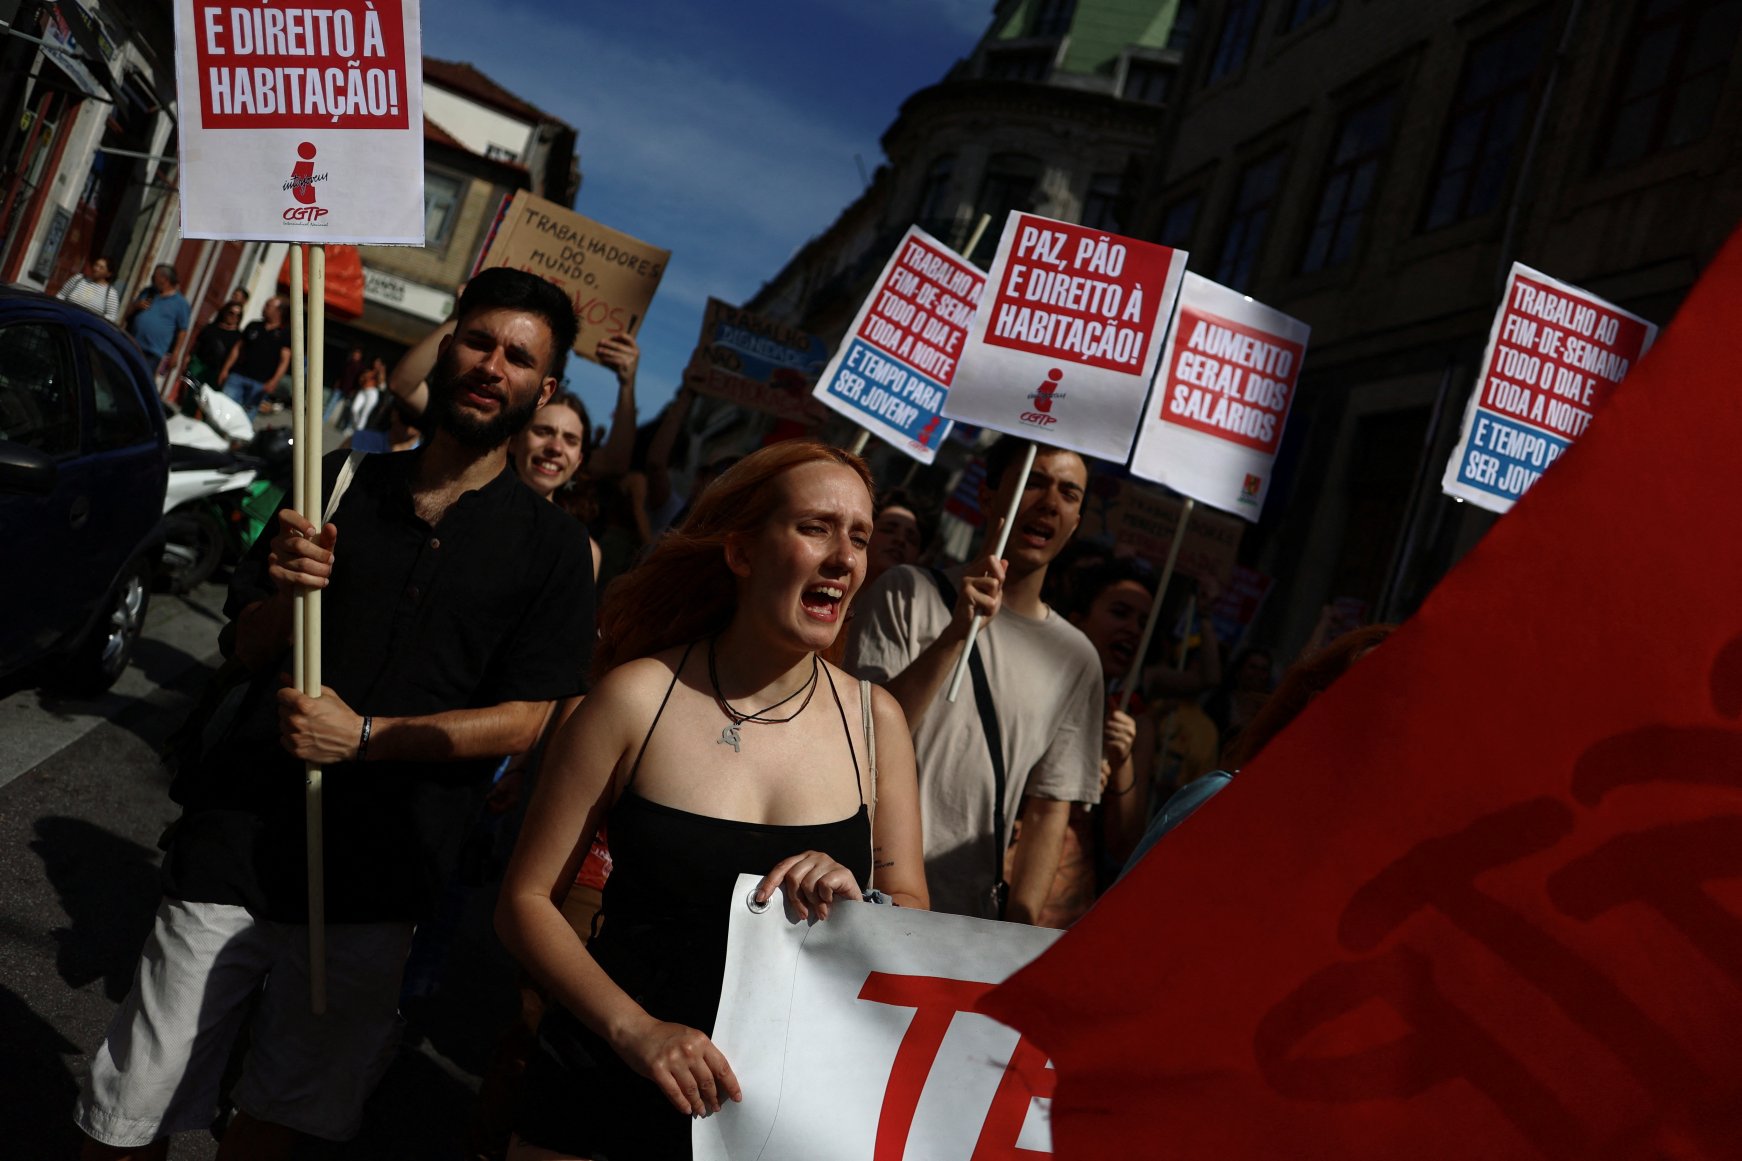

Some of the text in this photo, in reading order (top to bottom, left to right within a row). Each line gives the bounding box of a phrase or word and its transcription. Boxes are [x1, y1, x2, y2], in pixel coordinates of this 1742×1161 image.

[204, 1, 386, 58] E DIREITO À
[209, 60, 399, 123] HABITAÇÃO!
[283, 206, 328, 221] CGTP
[525, 208, 661, 280] TRABALHADORES
[530, 249, 599, 289] MUNDO,
[560, 246, 585, 266] DO
[902, 241, 983, 305] TRABALHO A
[1017, 226, 1127, 278] PAZ, PÃO
[876, 289, 961, 353] TODO O DIA E
[888, 266, 977, 330] FIM-DE-SEMA
[1006, 264, 1144, 323] E DIREITO À
[1513, 281, 1619, 346] TRABALHO AO
[864, 314, 955, 380] TODA A NOITE
[994, 303, 1144, 366] HABITAÇÃO!
[1188, 320, 1293, 378] AUMENTO
[1503, 314, 1629, 384] FIM-DE-SEMANA
[834, 369, 866, 401] SER
[860, 386, 919, 429] JOVEM?
[846, 345, 863, 368] E
[858, 350, 907, 393] TEMPO
[902, 376, 943, 413] PARA
[1175, 350, 1288, 412] GERAL DOS
[1496, 345, 1596, 406] TODO O DIA E
[1169, 383, 1277, 443] SALÁRIOS
[1487, 377, 1593, 437] TODA A NOITE
[1465, 450, 1542, 495] SER JOV
[1474, 418, 1490, 447] E
[1488, 422, 1546, 467] TEMPO
